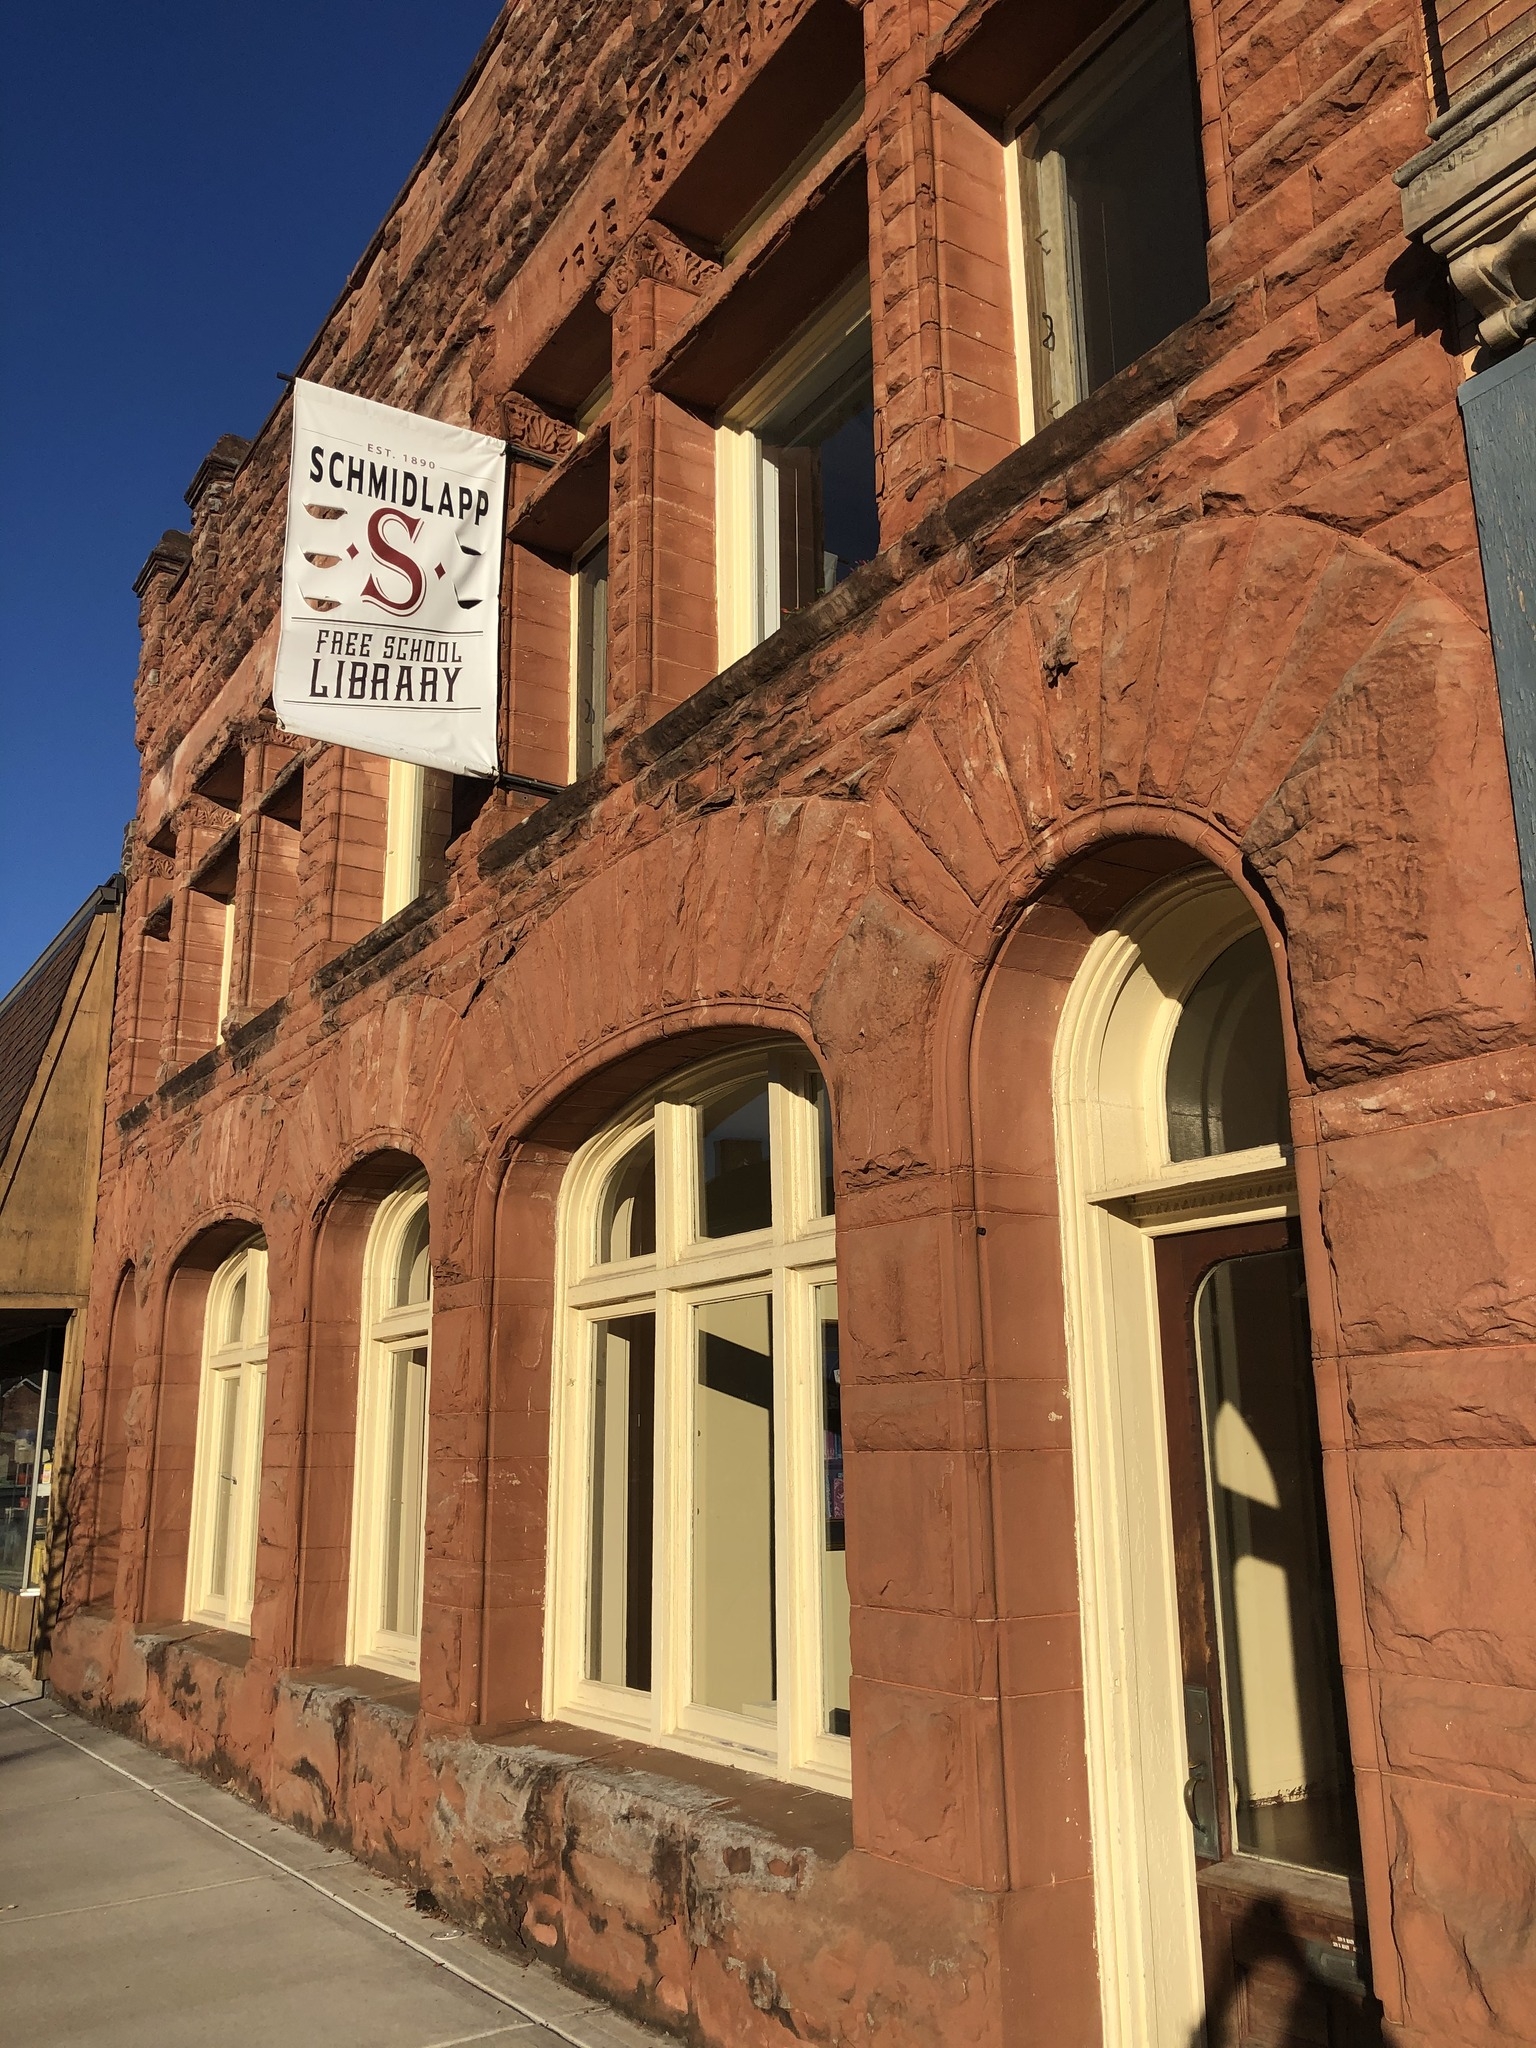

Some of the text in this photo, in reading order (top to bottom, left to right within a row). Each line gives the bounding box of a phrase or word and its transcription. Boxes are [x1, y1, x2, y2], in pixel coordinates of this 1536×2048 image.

[366, 442, 437, 471] EST. 1890
[310, 445, 489, 526] SCHMIDLAPP
[360, 507, 427, 617] S
[316, 629, 463, 664] FREE SCHOOL
[309, 658, 463, 703] LIBRARY
